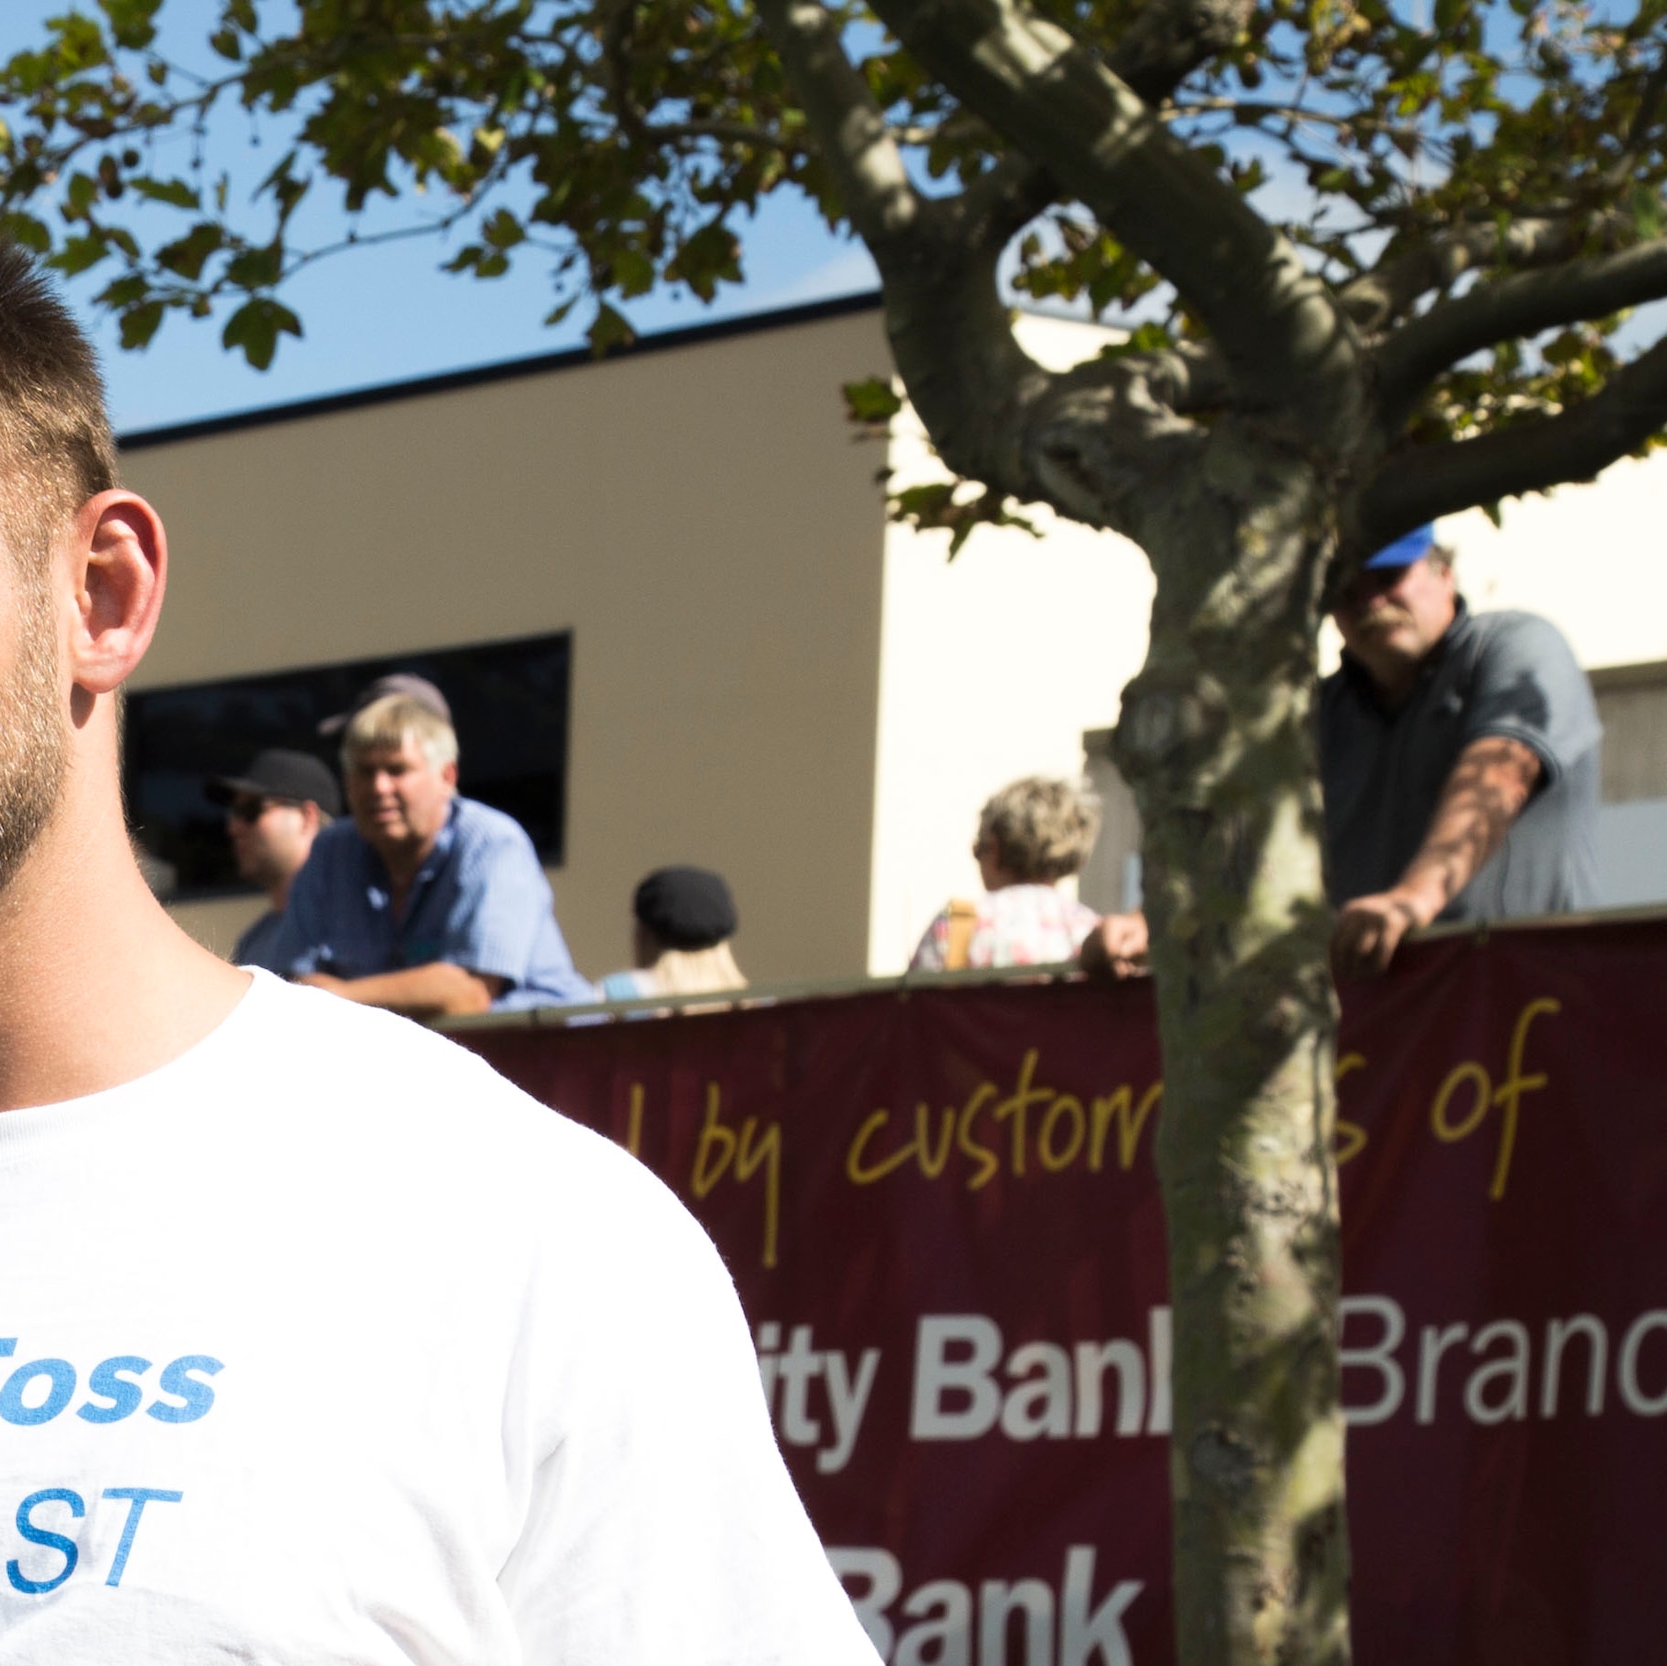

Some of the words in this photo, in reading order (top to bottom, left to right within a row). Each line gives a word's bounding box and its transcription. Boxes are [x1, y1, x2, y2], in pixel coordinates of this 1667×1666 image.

[691, 1081, 780, 1268] by
[846, 1048, 1367, 1191] customs
[1430, 997, 1560, 1202] of
[909, 1307, 1173, 1442] Ban
